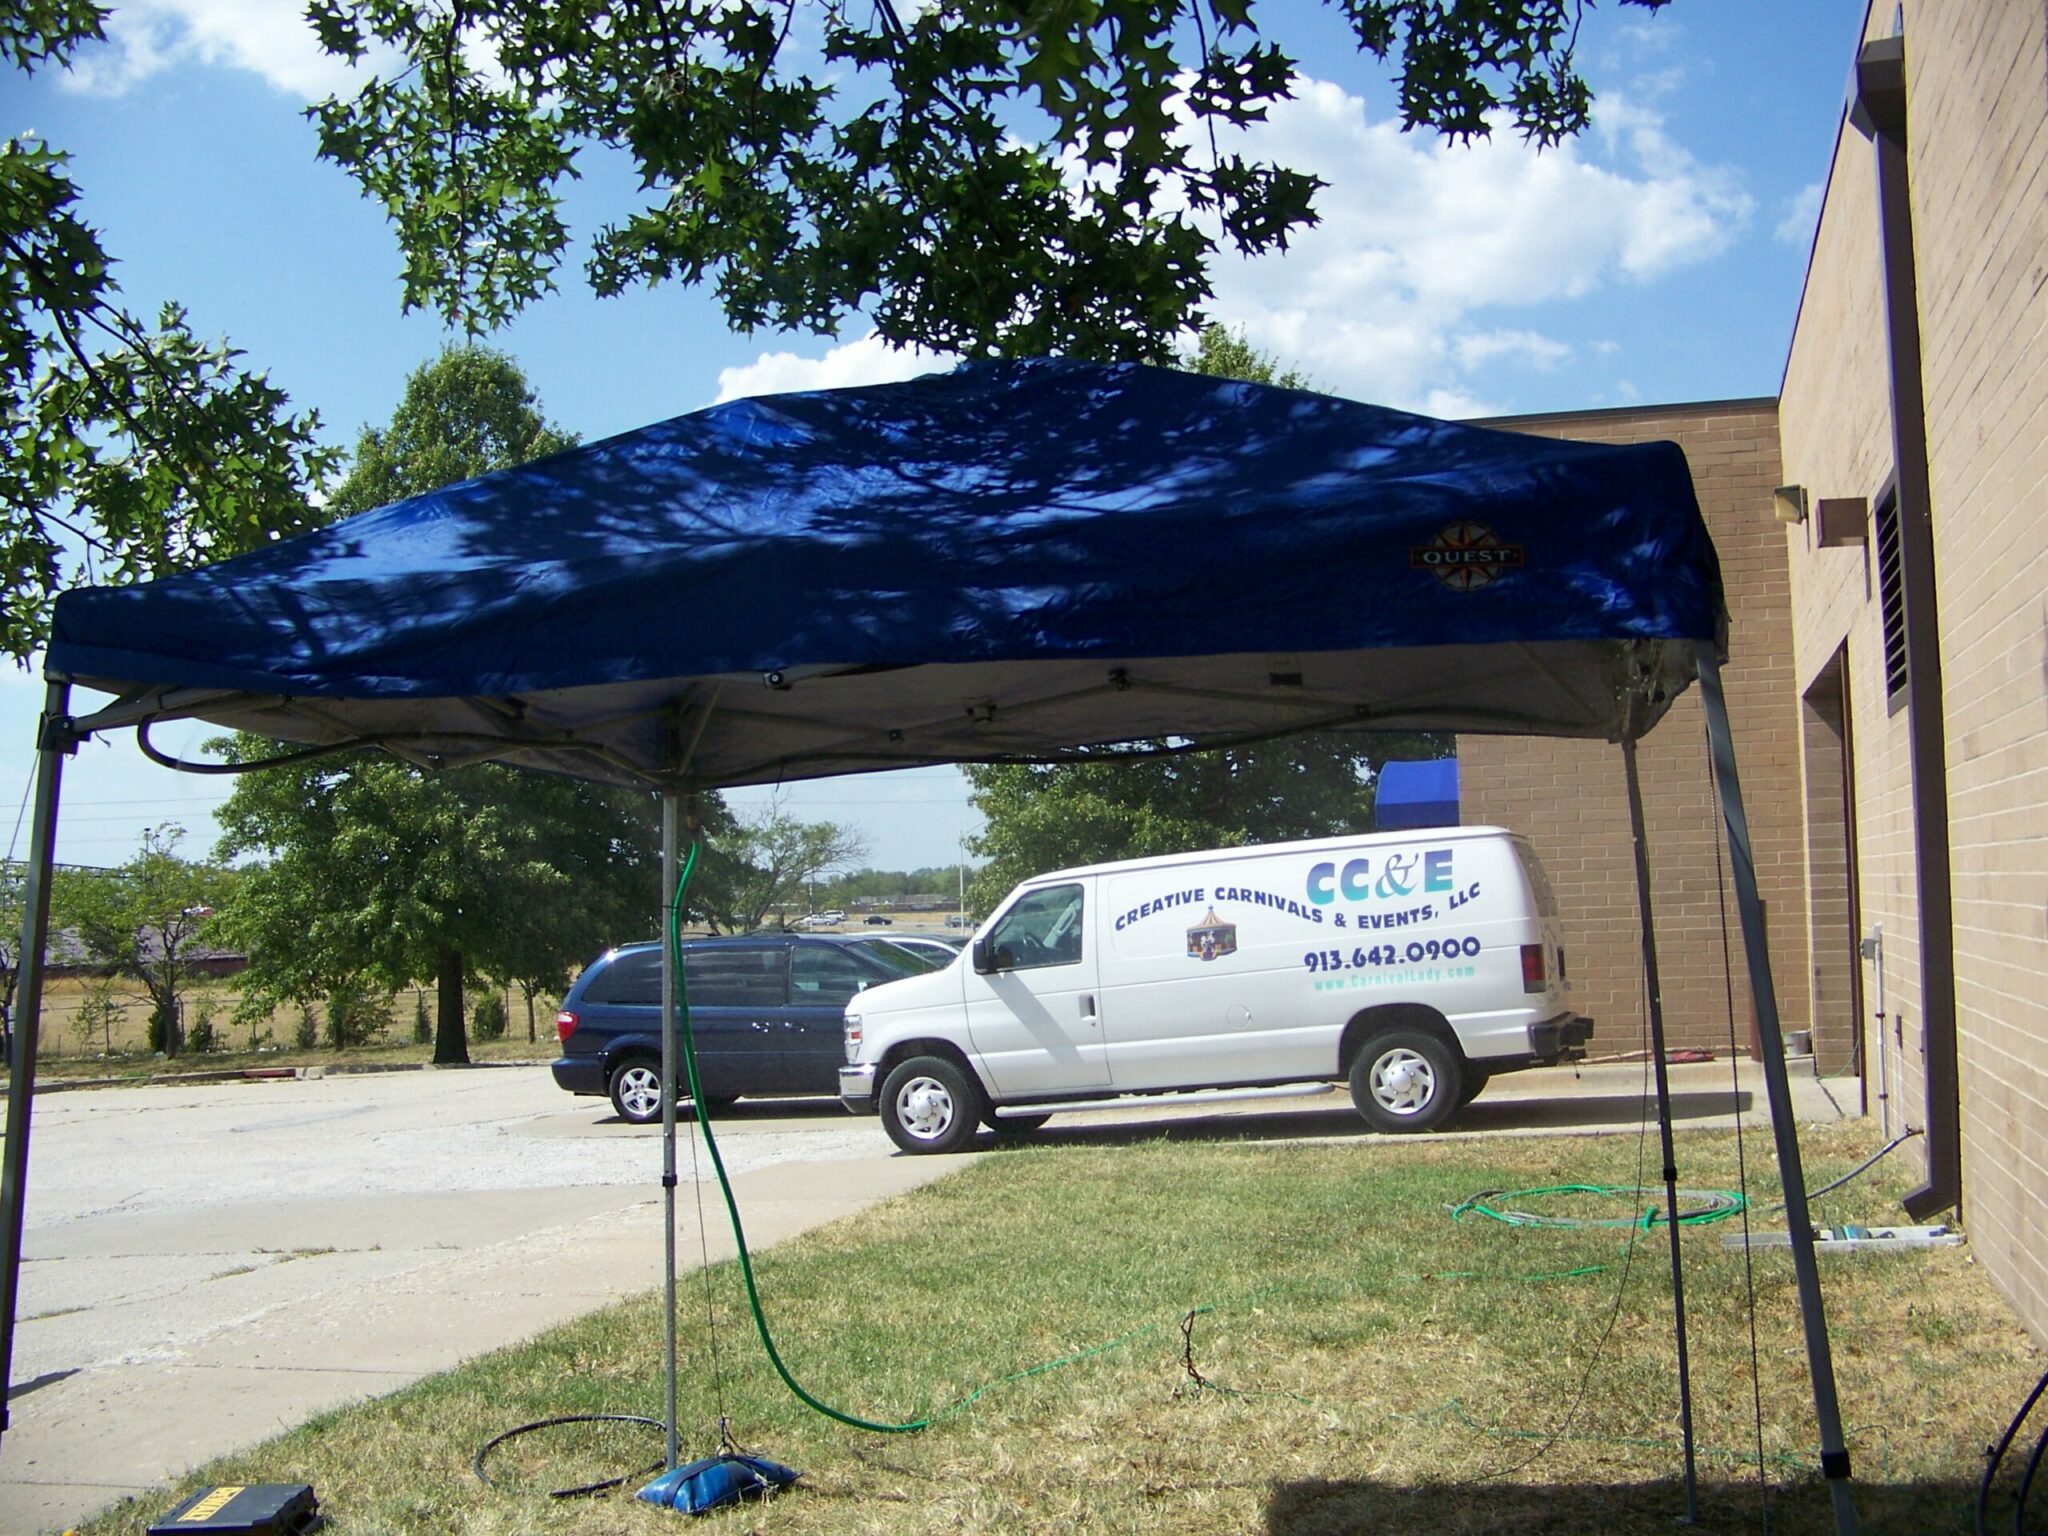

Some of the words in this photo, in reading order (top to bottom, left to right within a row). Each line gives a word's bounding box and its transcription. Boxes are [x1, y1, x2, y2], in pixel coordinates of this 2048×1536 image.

[1423, 550, 1510, 564] QUEST
[1306, 849, 1453, 905] CC&E
[1115, 888, 1205, 932] CREATIVE
[1214, 887, 1323, 924] CARNIVALS
[1334, 912, 1347, 928] &
[1357, 904, 1439, 929] EVENTS,
[1448, 882, 1481, 911] LLC
[1304, 936, 1481, 973] 913.642.0900
[1313, 965, 1475, 992] www.CarnivalLady.com
